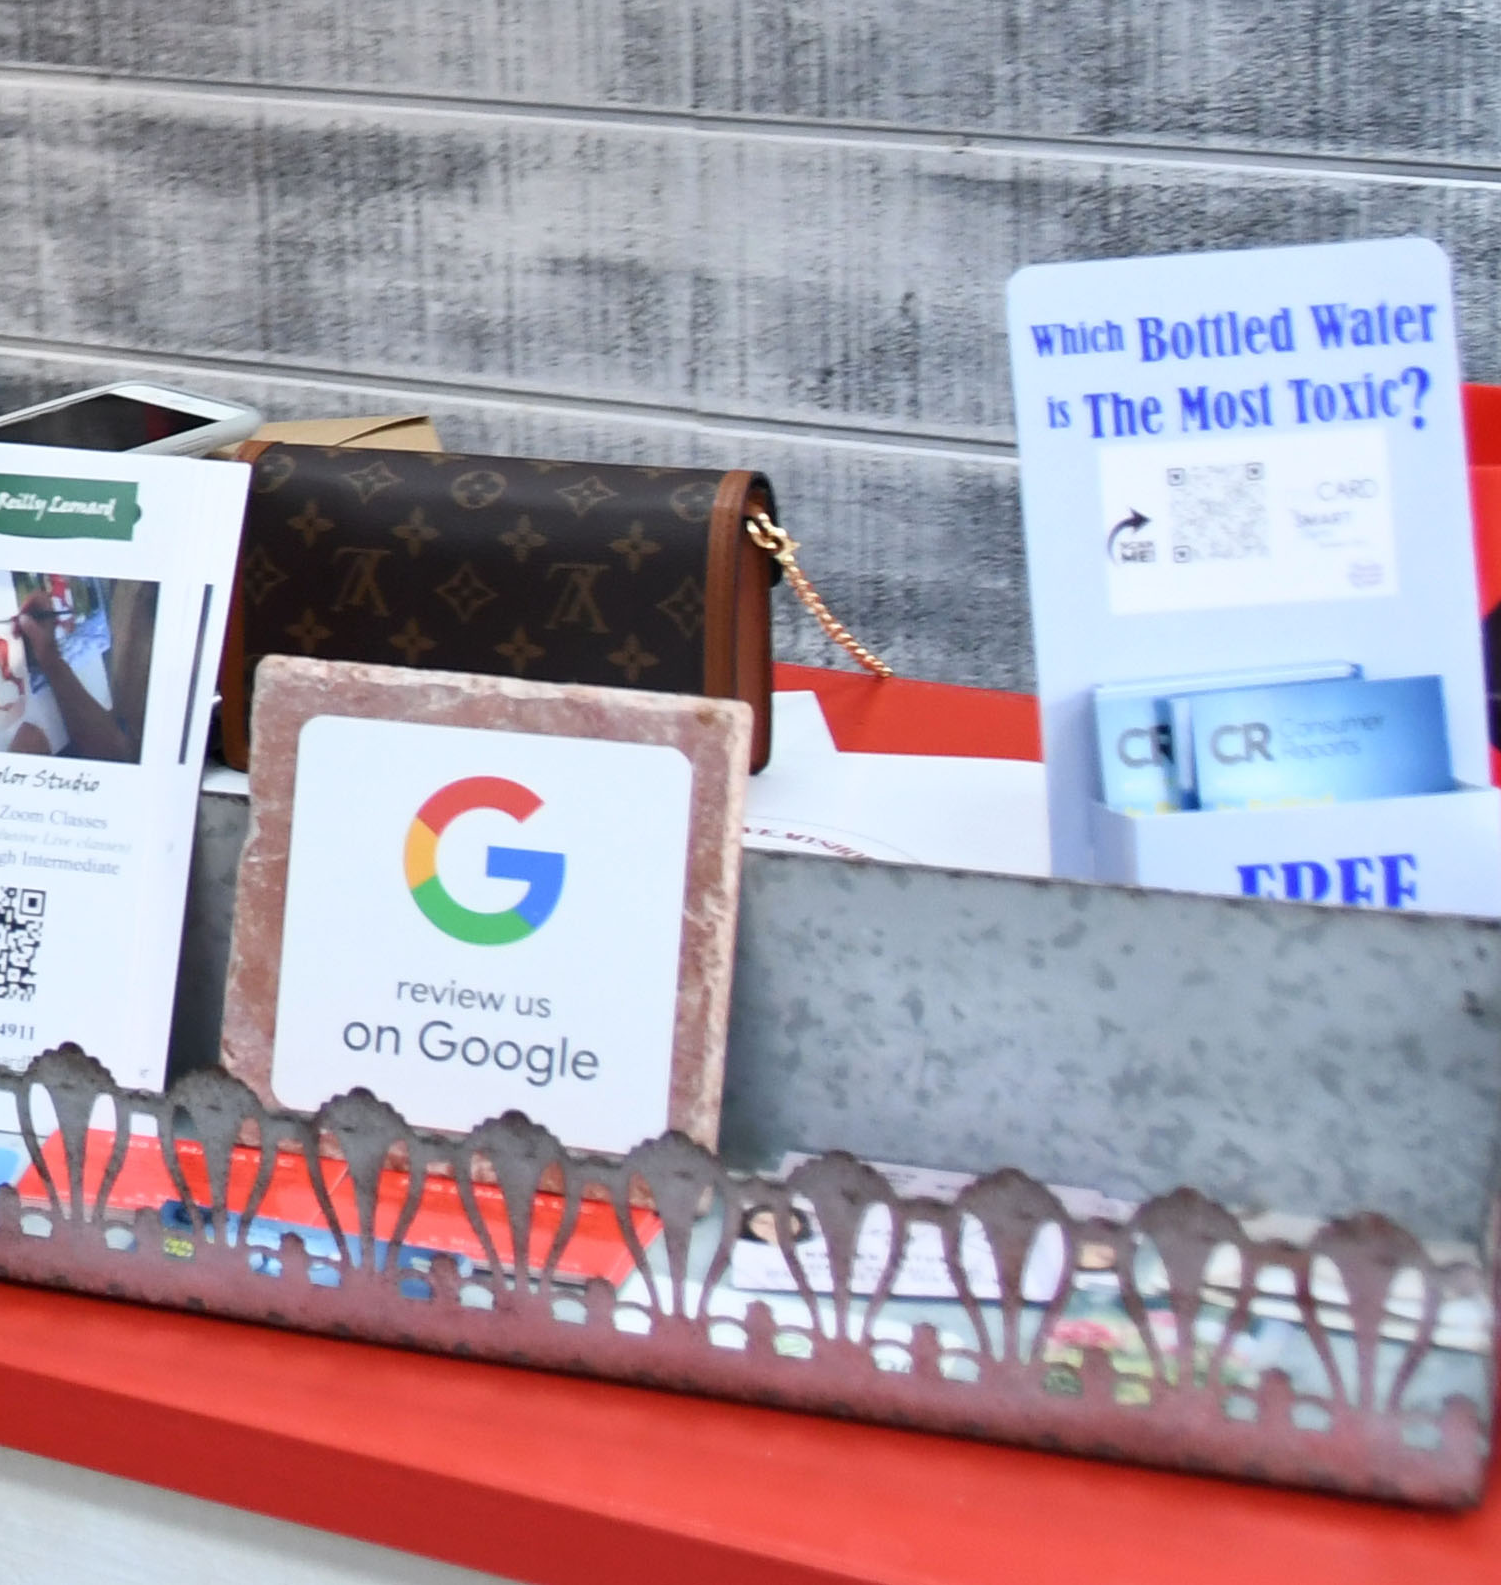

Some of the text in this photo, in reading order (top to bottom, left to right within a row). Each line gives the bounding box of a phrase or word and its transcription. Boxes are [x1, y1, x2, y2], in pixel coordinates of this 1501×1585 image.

[1030, 302, 1437, 362] Which Bottled Water
[1047, 365, 1432, 439] is The Most Toxic?
[1209, 721, 1276, 765] CR
[32, 768, 100, 794] Studio
[49, 809, 108, 831] Classes
[21, 850, 121, 876] Intermediate
[403, 775, 566, 946] G
[396, 979, 552, 1019] review us
[342, 1019, 600, 1087] on Google
